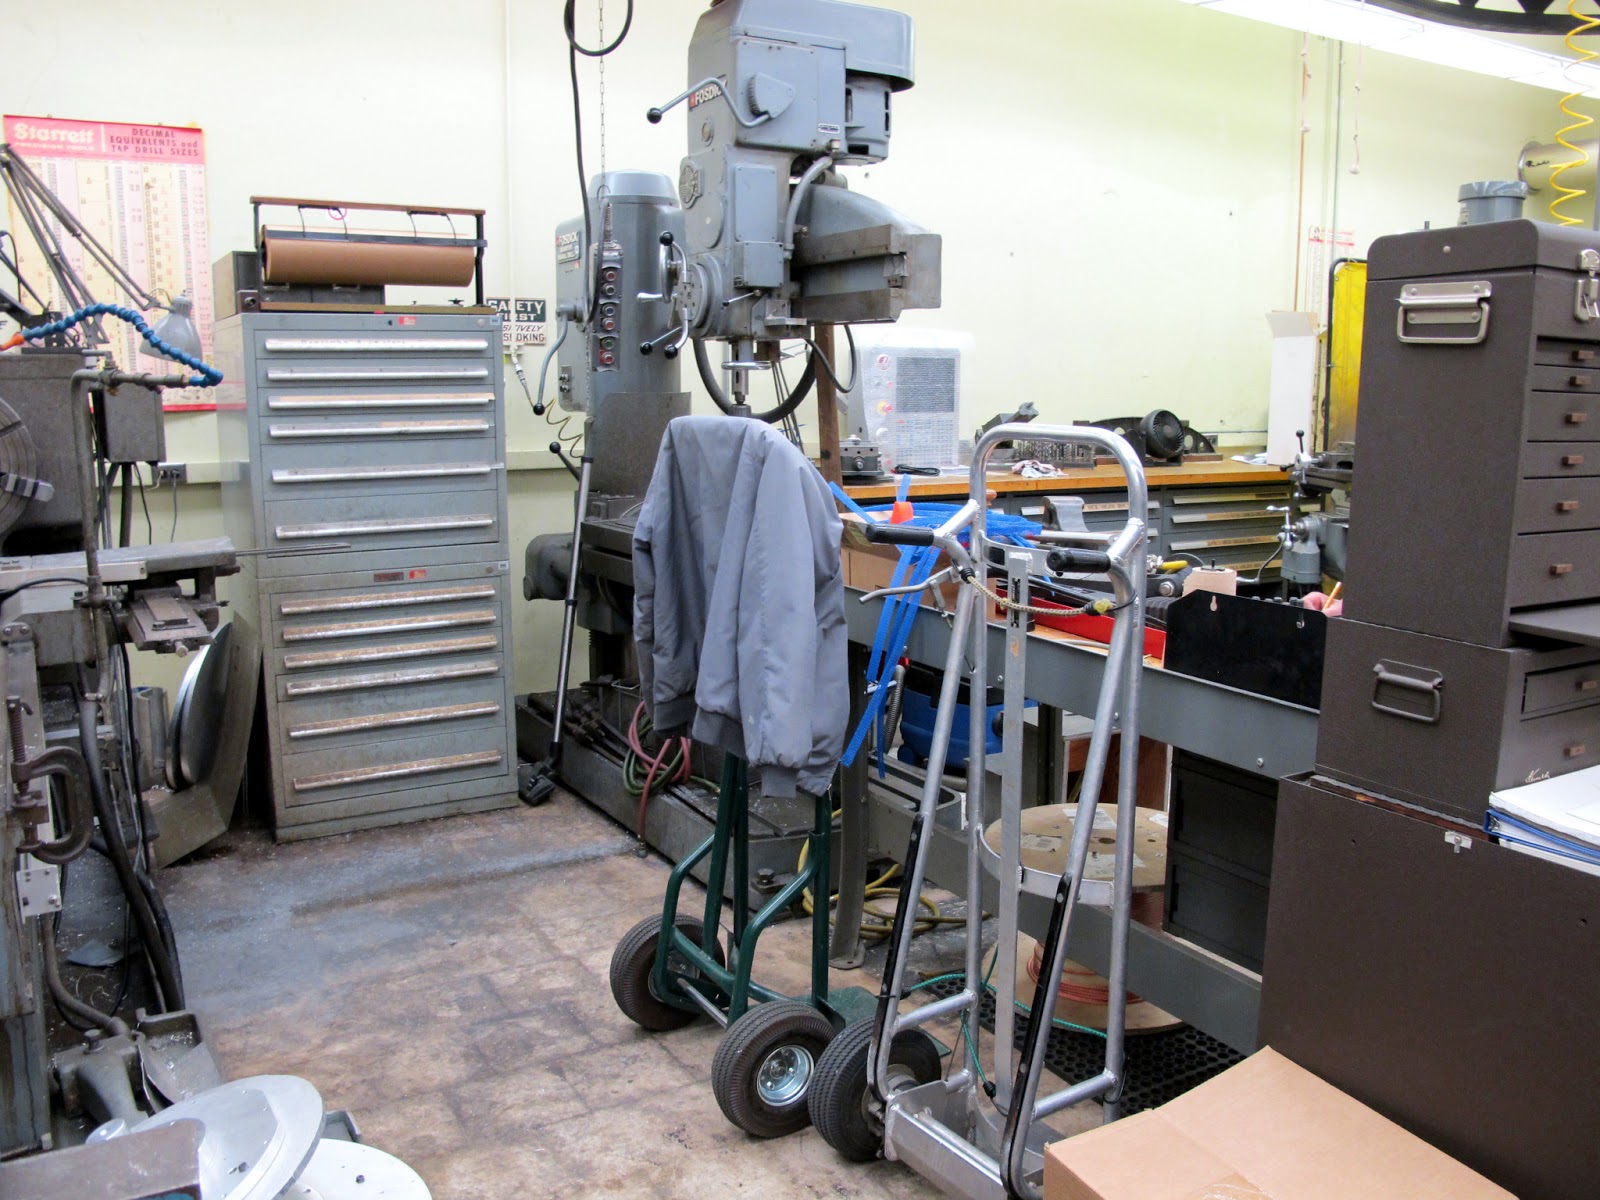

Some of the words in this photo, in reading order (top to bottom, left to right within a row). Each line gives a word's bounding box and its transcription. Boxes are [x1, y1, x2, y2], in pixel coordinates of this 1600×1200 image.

[14, 123, 95, 143] Starrett
[132, 128, 175, 138] DECIMAL
[110, 136, 176, 147] EQUIVALENTS
[135, 146, 164, 154] DRILL
[170, 148, 199, 157] SIZES
[488, 300, 544, 314] SAETY
[503, 333, 545, 342] SOKING
